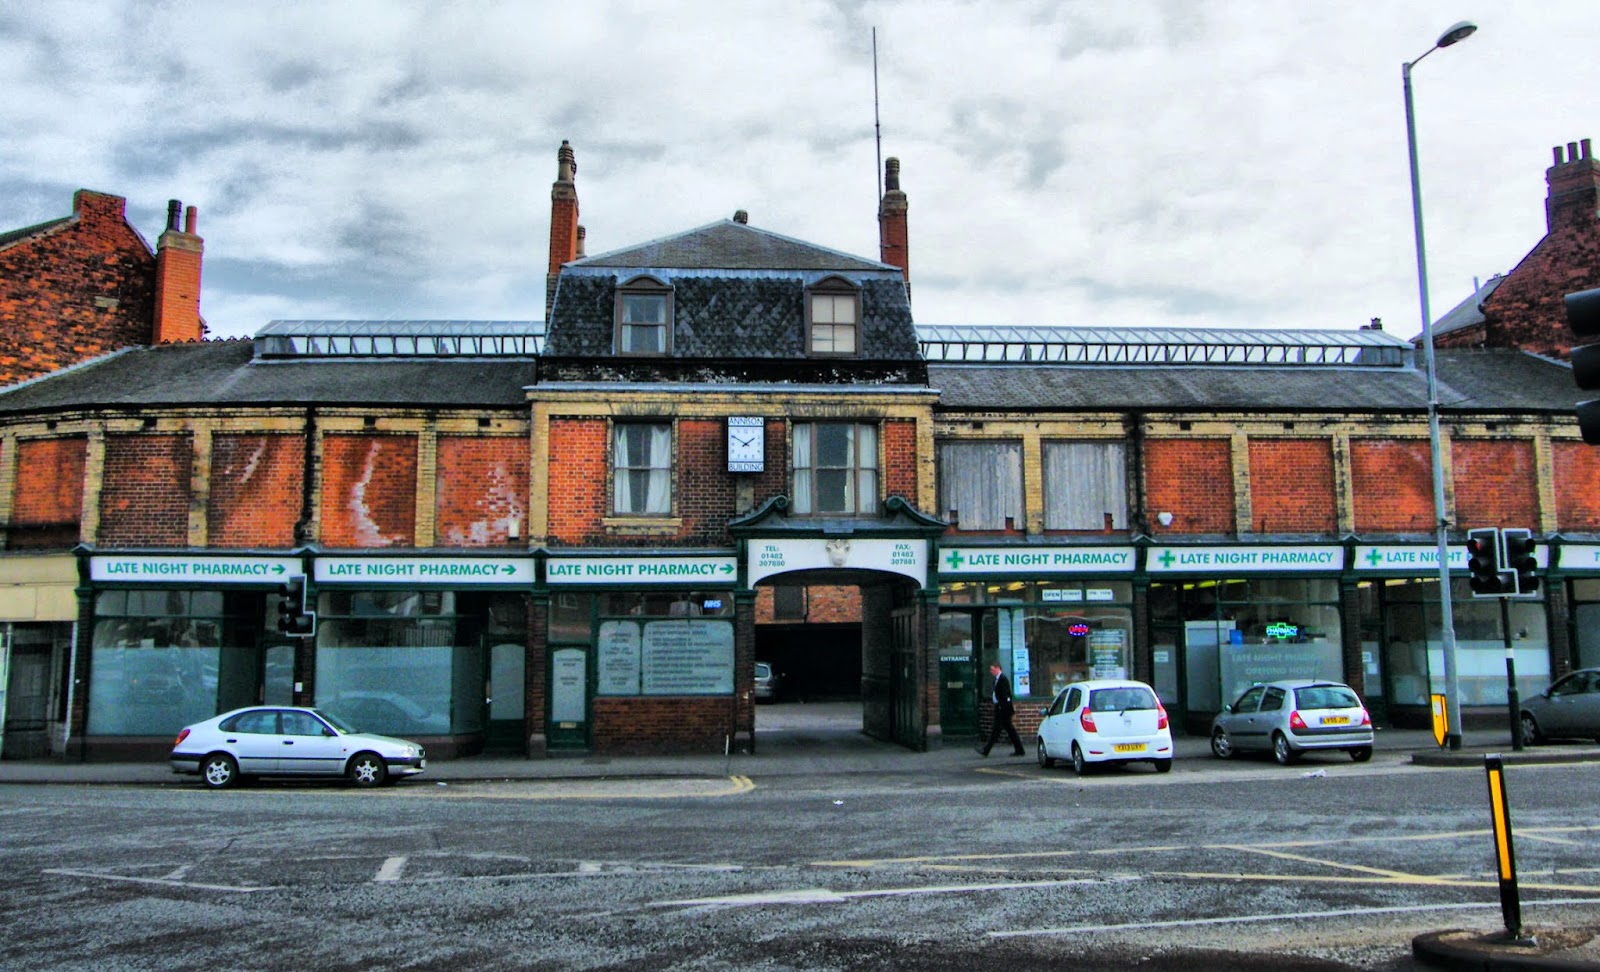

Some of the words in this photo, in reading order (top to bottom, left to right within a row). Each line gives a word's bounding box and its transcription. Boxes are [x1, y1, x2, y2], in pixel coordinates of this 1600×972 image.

[729, 417, 763, 425] ANNISON
[969, 554, 999, 565] LATE
[1004, 554, 1049, 565] NIGHT
[1054, 553, 1128, 564] PHARMACY
[1180, 553, 1210, 564] LATE
[1214, 553, 1257, 564] NIGHT
[1261, 552, 1333, 563] PHARMACY
[1386, 552, 1415, 562] LATE
[107, 562, 138, 574] LATE
[142, 563, 188, 574] NIGHT
[193, 563, 268, 575] PHARMACY
[329, 564, 362, 575] LATE
[367, 564, 415, 575] NIGHT
[420, 564, 498, 575] PHARMACY
[549, 564, 581, 575] LATE
[586, 564, 634, 575] NIGHT
[639, 564, 717, 575] PHARMACY
[703, 599, 721, 608] NHS
[1266, 627, 1298, 635] PHARMACY
